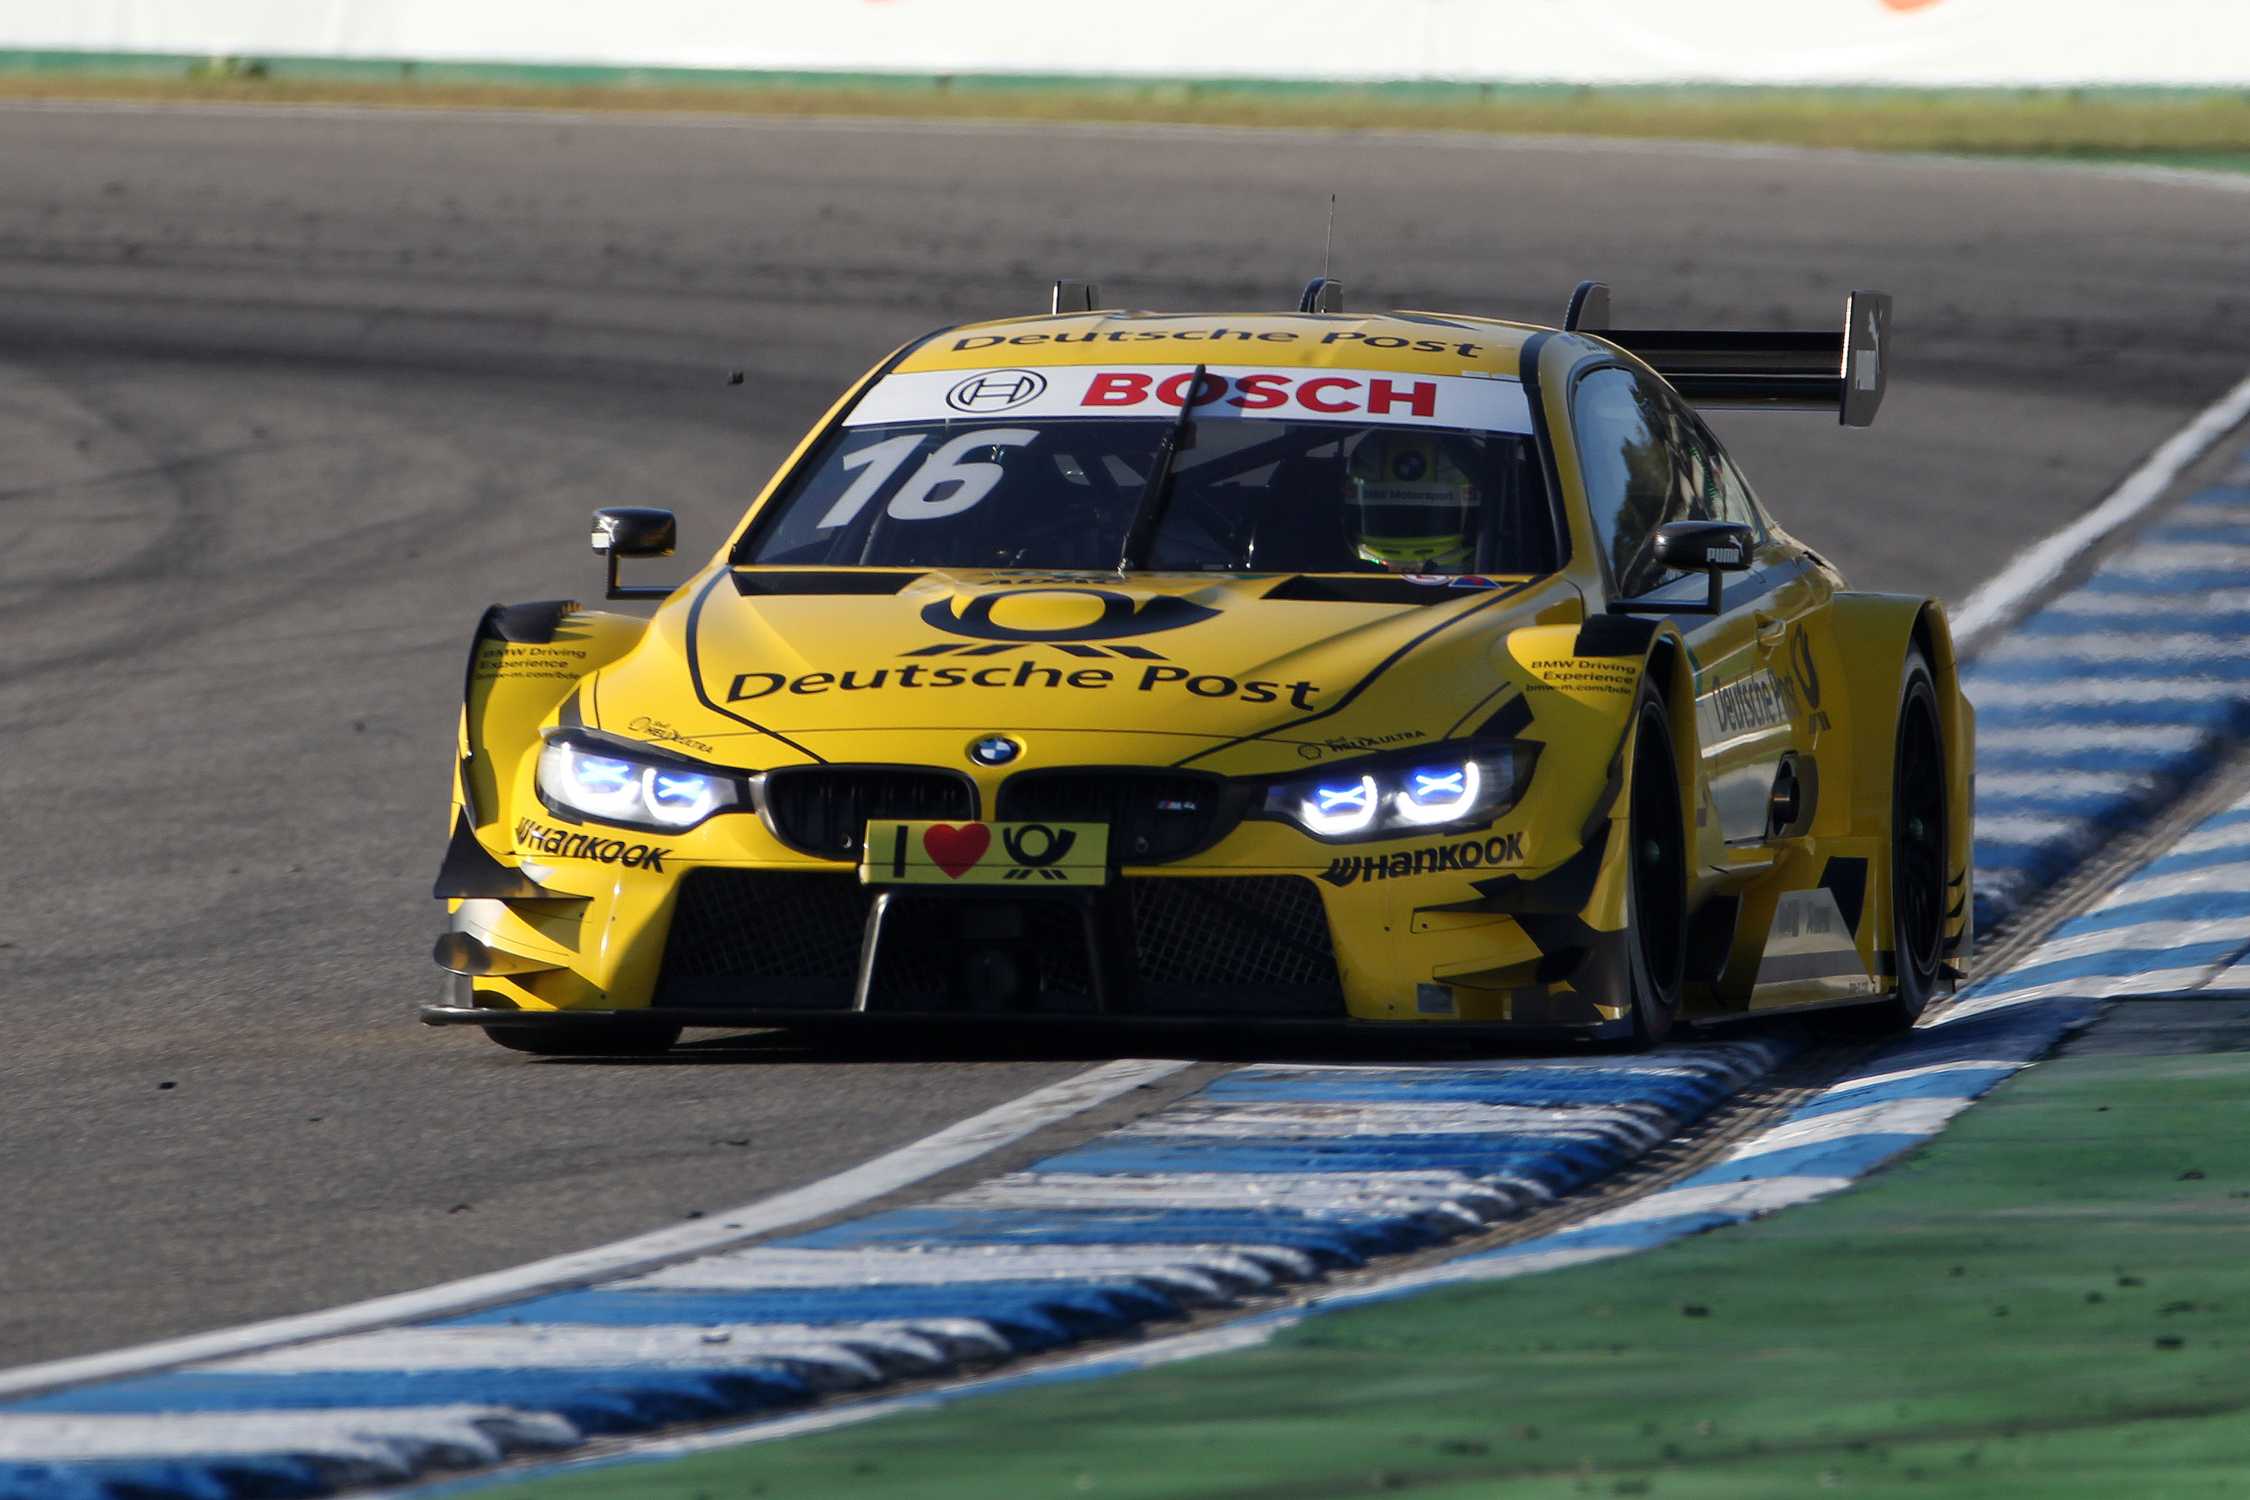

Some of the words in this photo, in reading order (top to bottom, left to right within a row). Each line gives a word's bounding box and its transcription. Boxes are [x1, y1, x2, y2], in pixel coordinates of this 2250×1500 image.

[951, 327, 1299, 352] Deutsche
[1320, 331, 1483, 359] Post
[1081, 370, 1438, 417] BOSCH
[816, 427, 1041, 530] 16
[1706, 547, 1740, 563] PUMA
[529, 648, 587, 660] Driving
[1530, 660, 1575, 669] BMW
[1578, 660, 1637, 674] Driving
[1543, 671, 1634, 684] Experience
[727, 660, 1114, 703] Deutsche
[1138, 664, 1321, 712] Post
